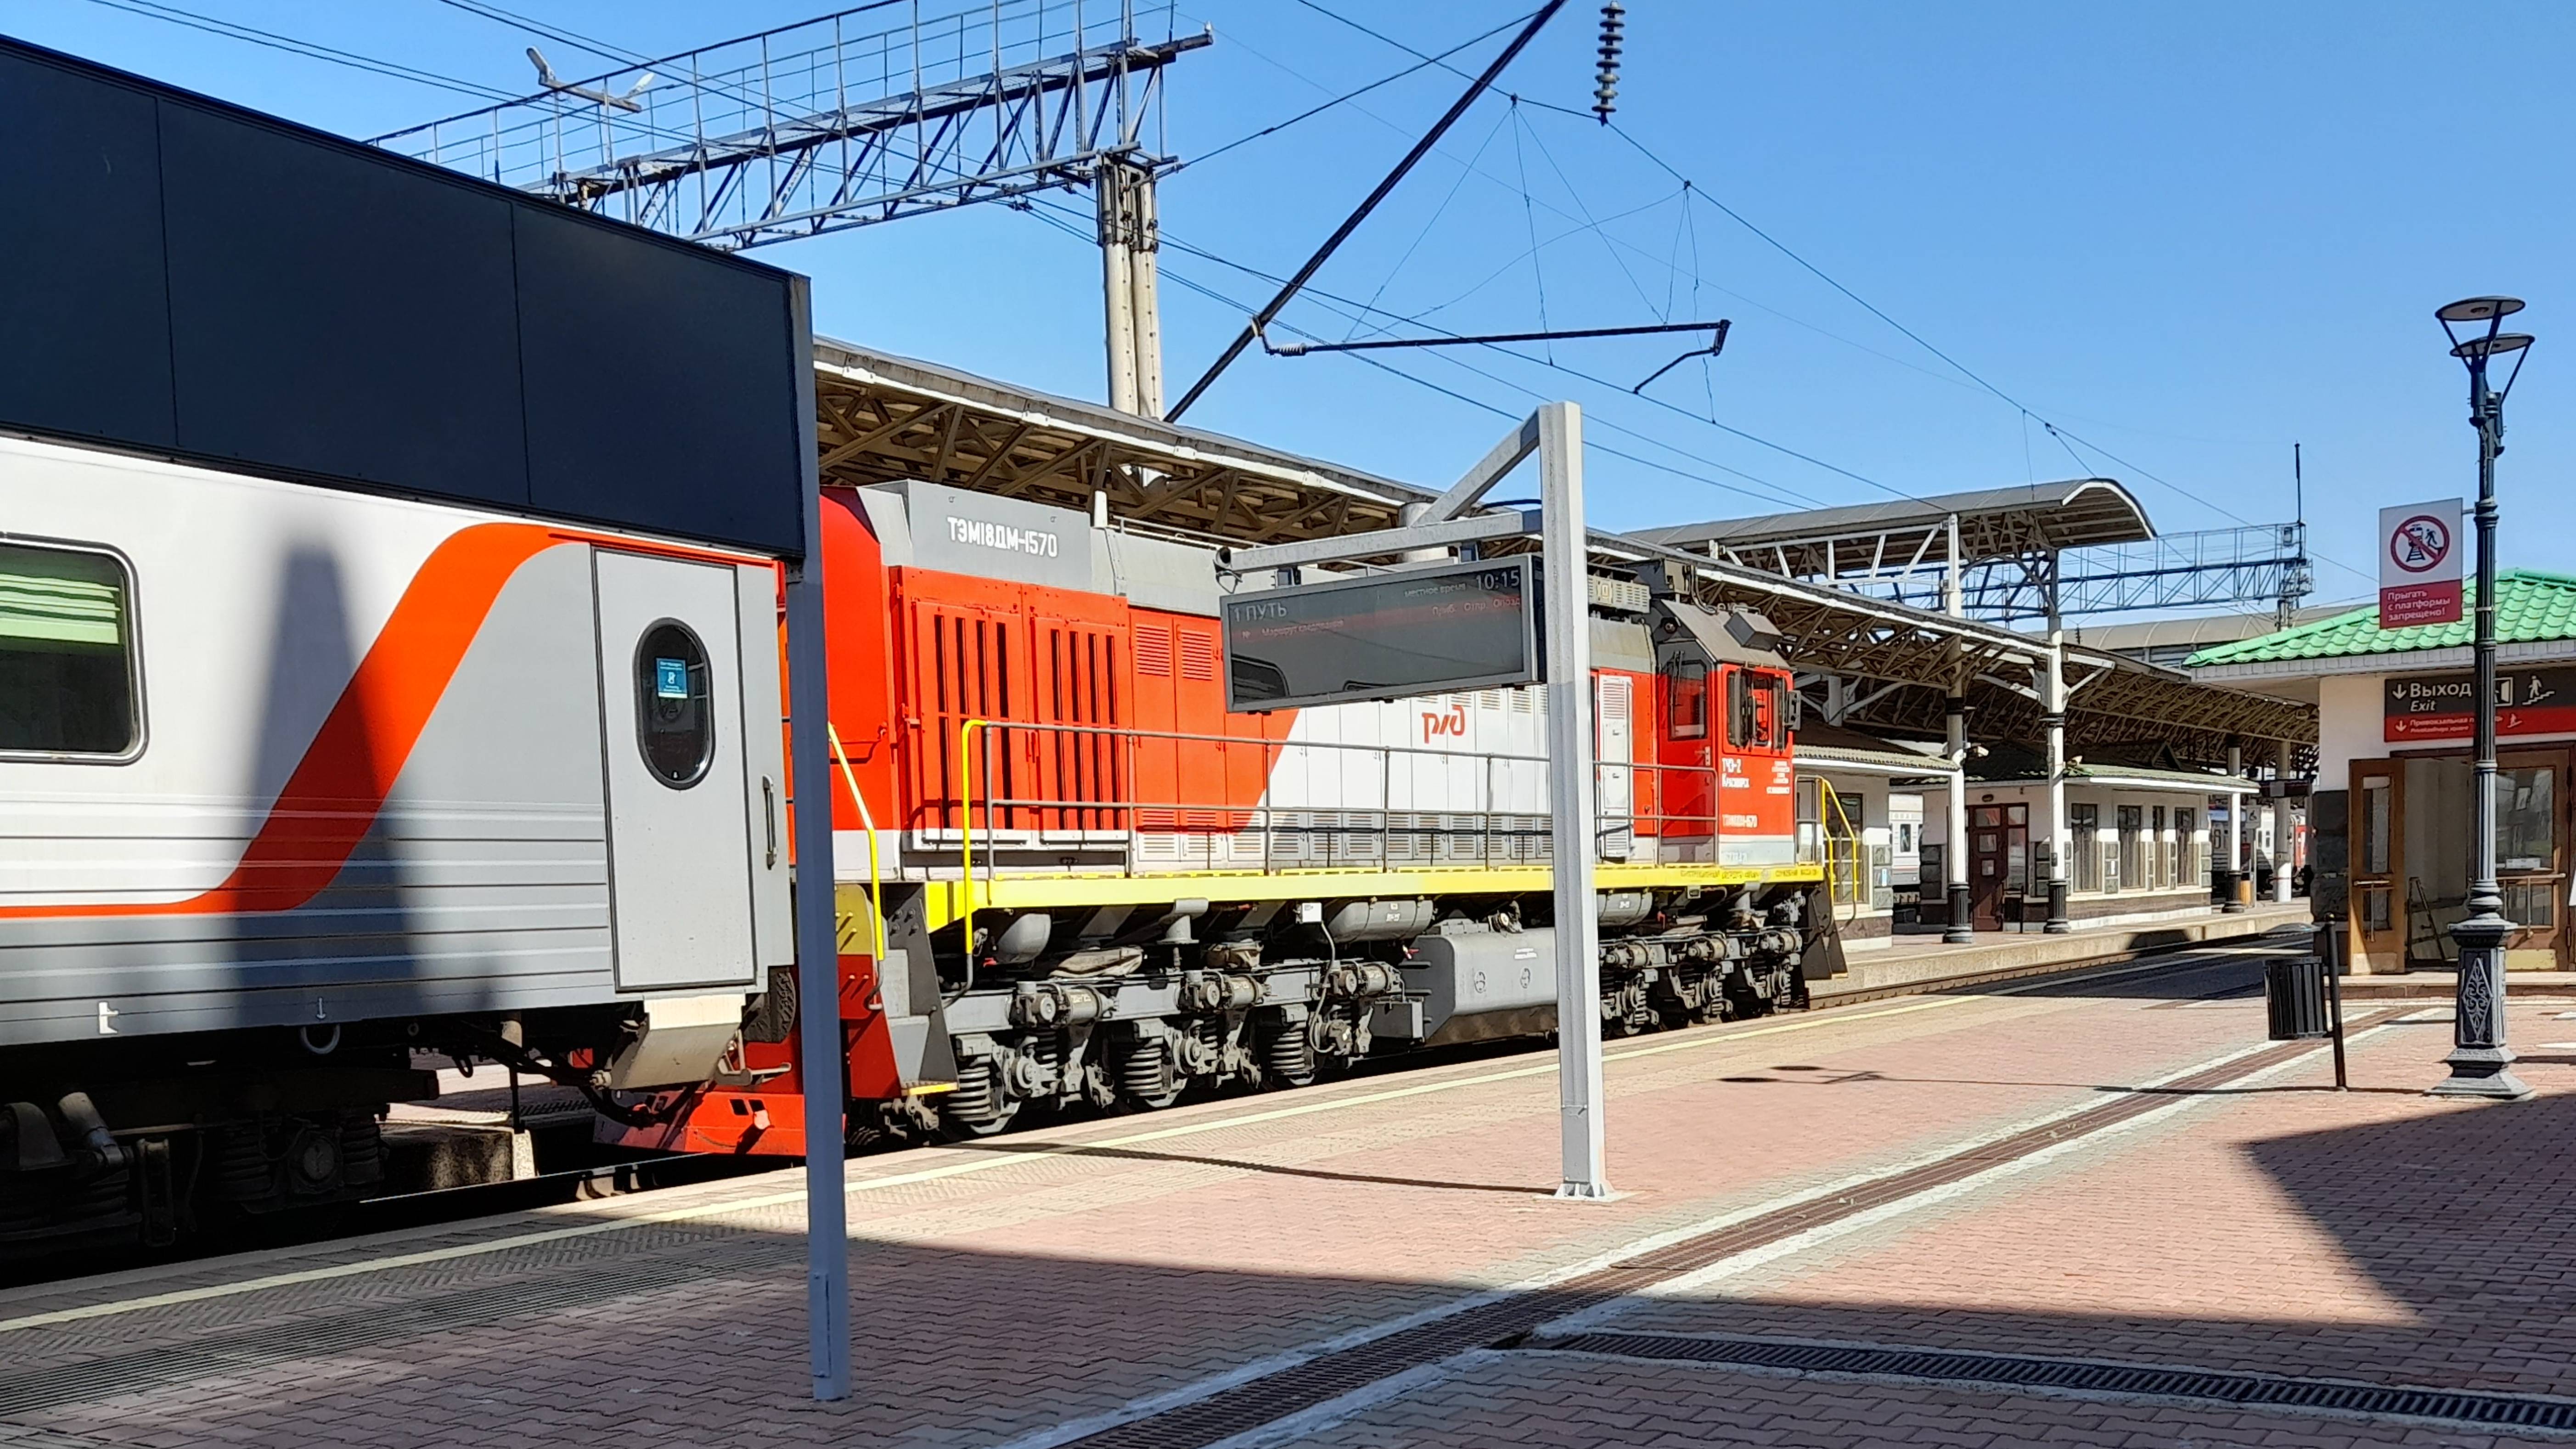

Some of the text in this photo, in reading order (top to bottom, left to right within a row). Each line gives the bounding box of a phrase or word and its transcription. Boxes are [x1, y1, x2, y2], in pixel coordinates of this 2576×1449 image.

[947, 516, 1058, 558] ТЭМ18ДМ-1570
[1476, 569, 1519, 591] 10:15
[2387, 590, 2427, 601] Прыгать
[2395, 598, 2451, 610] платформы
[1234, 602, 1287, 622] 1 ПУТЬ
[2388, 607, 2445, 621] запрещено!
[2410, 682, 2472, 698] Выход
[2410, 700, 2435, 712] Exit
